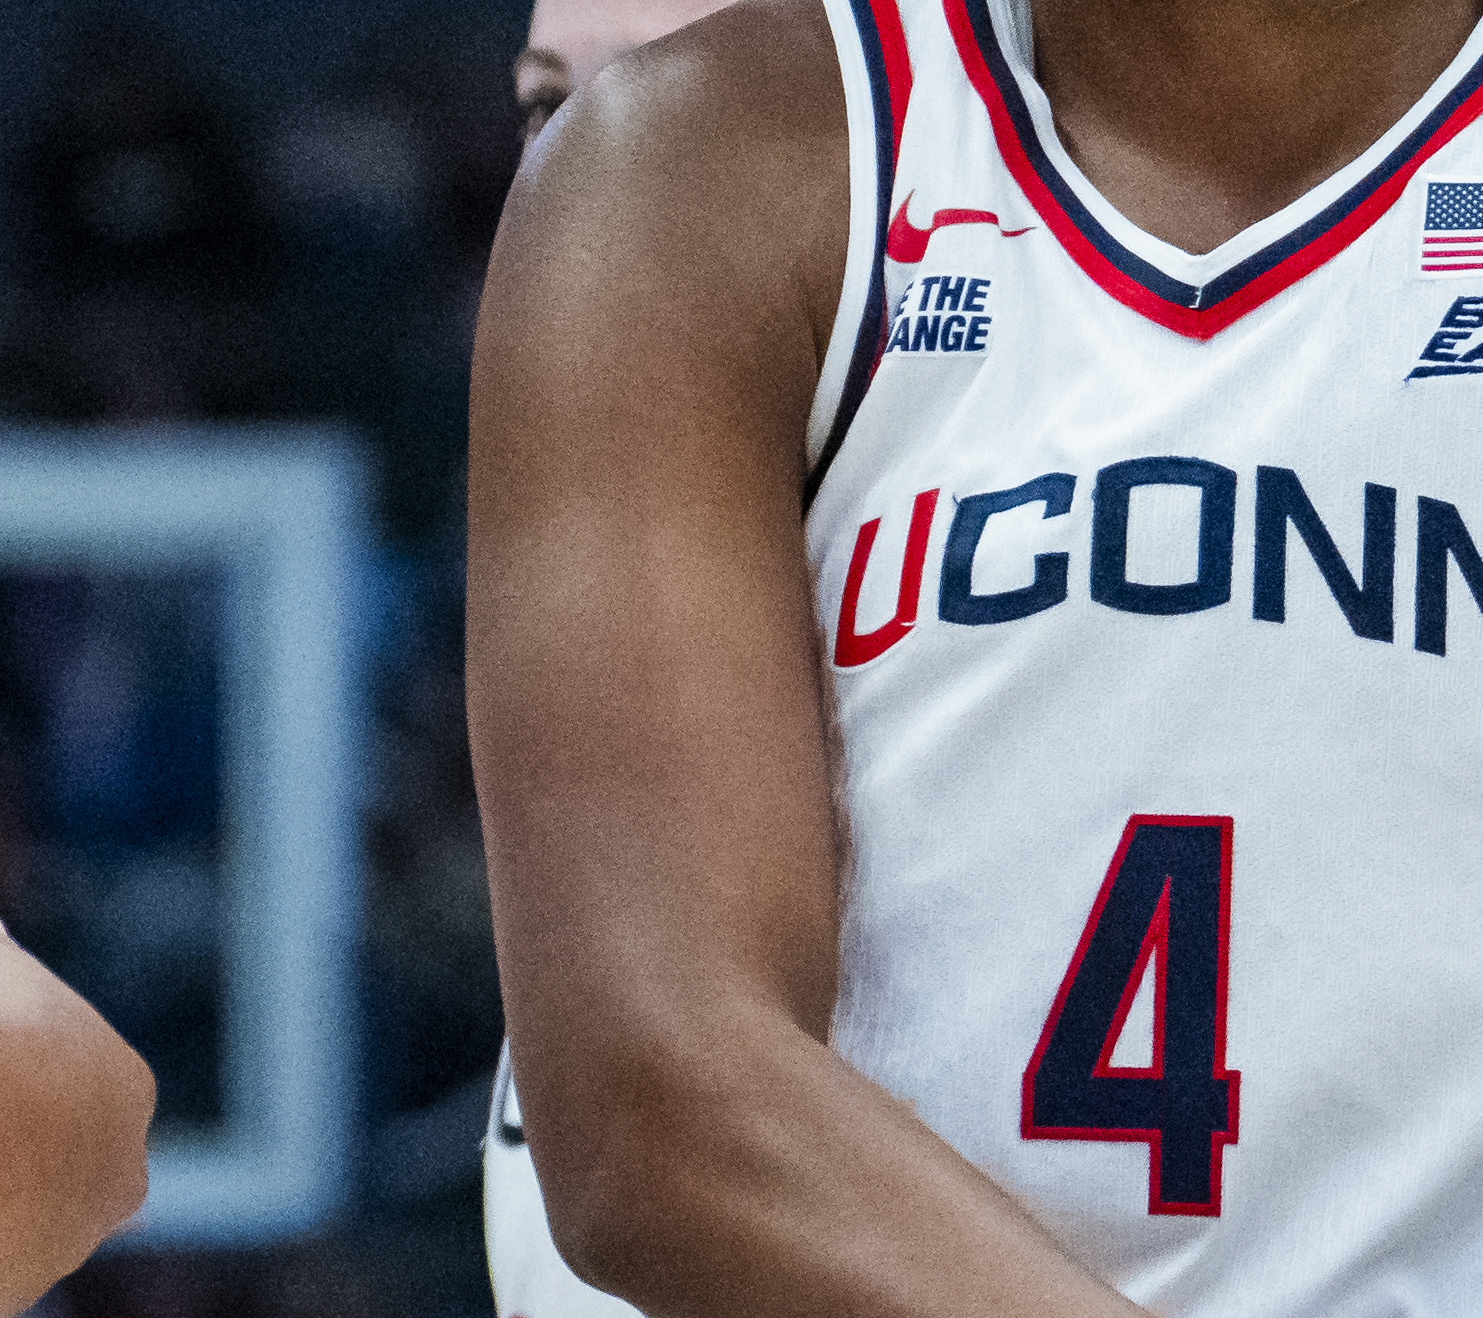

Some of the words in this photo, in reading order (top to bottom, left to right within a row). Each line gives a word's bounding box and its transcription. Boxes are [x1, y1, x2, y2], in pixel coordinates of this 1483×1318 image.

[917, 275, 992, 313] THE
[885, 314, 993, 354] ANGE
[1021, 814, 1241, 1218] 4
